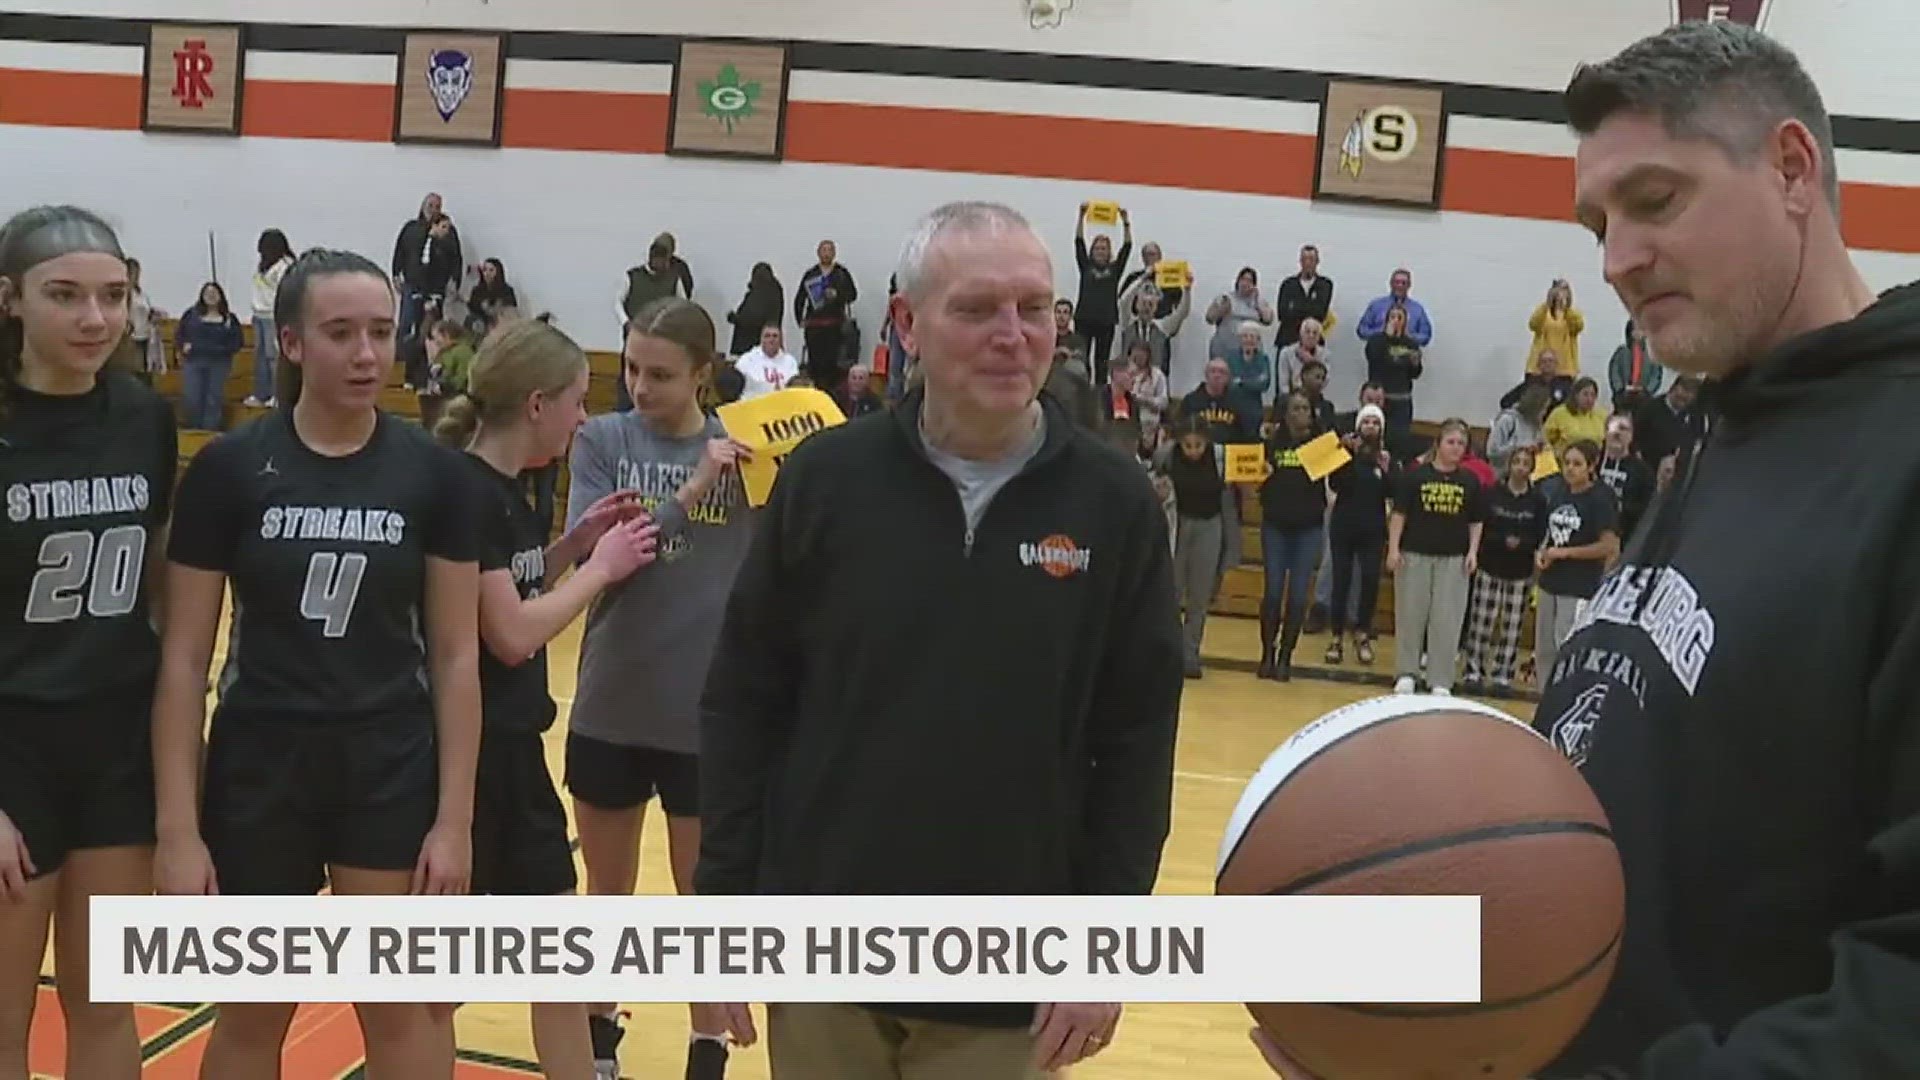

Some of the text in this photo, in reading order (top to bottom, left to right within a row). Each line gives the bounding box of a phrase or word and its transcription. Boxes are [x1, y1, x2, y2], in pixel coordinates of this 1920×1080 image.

[710, 86, 747, 111] G
[1373, 113, 1405, 153] S
[760, 410, 825, 443] 1000
[6, 473, 150, 522] STREAKS
[260, 505, 405, 545] STREAKS
[24, 524, 147, 623] 20
[300, 551, 368, 638] 4
